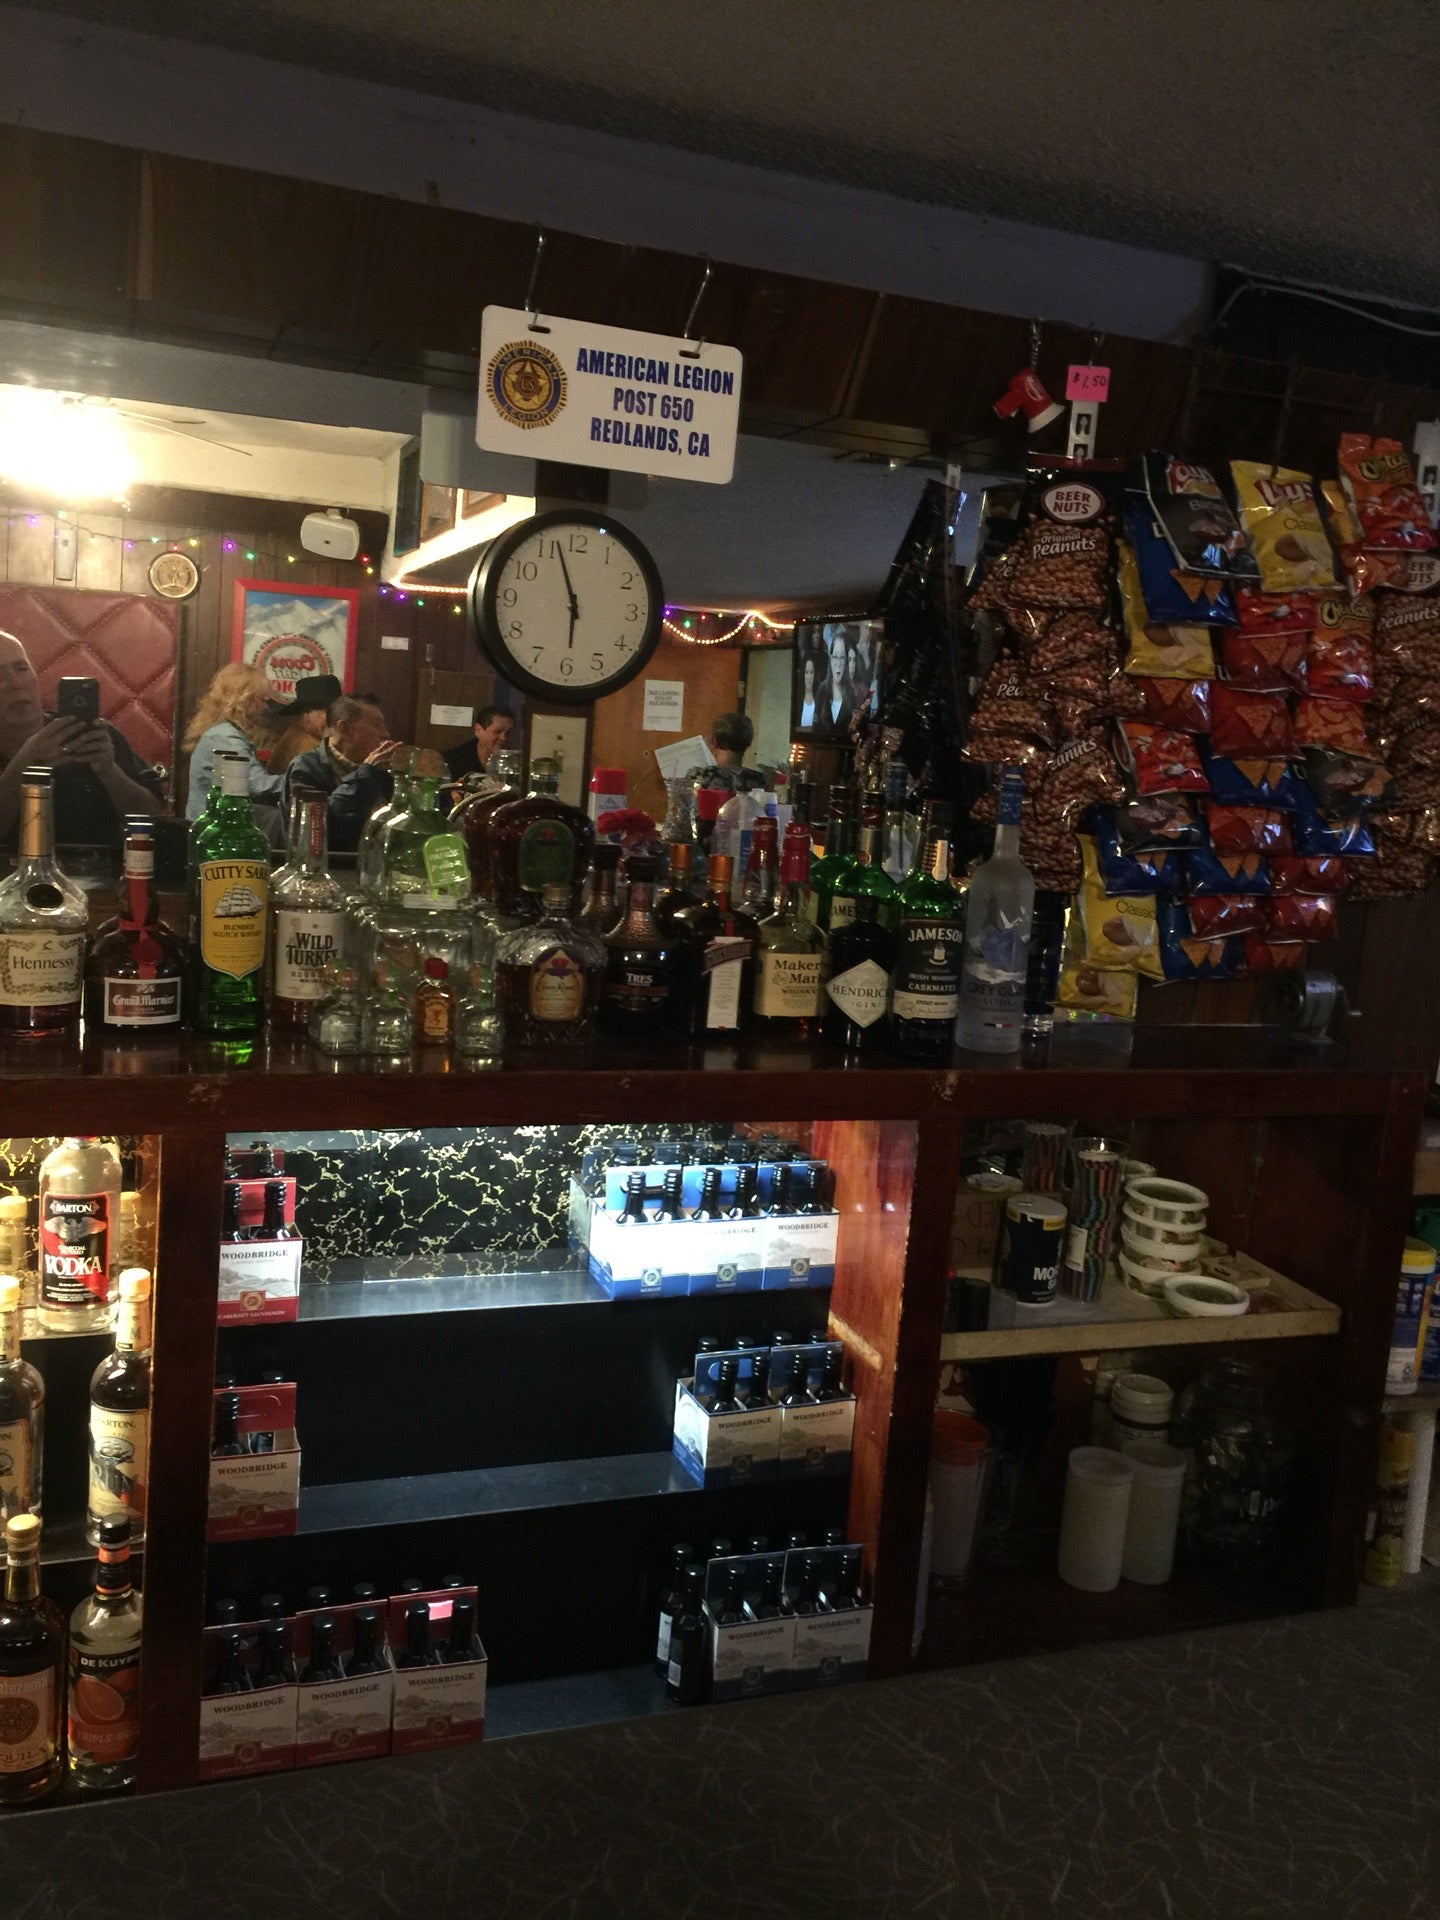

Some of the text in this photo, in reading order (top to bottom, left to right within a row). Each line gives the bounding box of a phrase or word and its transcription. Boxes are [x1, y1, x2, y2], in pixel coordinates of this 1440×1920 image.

[499, 348, 560, 381] AMERICAN
[576, 347, 734, 395] AMERICAN LEGION
[521, 379, 535, 391] US
[503, 401, 549, 421] LEGION
[612, 387, 694, 422] POST 650
[590, 416, 710, 457] REDLANDS, CA
[1055, 491, 1091, 503] BEER
[1053, 502, 1090, 515] NUTS
[569, 534, 588, 554] 12
[1041, 531, 1081, 544] Original
[538, 539, 556, 559] 11
[604, 547, 610, 565] 1
[1032, 537, 1097, 559] Peanuts
[516, 560, 538, 582] 10
[1410, 561, 1435, 572] EER
[620, 572, 633, 590] 2
[1410, 574, 1434, 585] UTS
[503, 588, 518, 608] 9
[625, 604, 639, 622] 3
[509, 620, 523, 639] 8
[614, 634, 627, 651] 4
[532, 646, 544, 664] 7
[590, 653, 604, 671] 5
[560, 657, 573, 676] 6
[205, 865, 243, 881] CUTTY
[295, 932, 333, 950] WILD
[13, 956, 74, 971] Hennessy
[285, 944, 339, 967] TURKEY
[625, 972, 654, 985] TRES
[55, 1203, 93, 1214] BARTON
[777, 1222, 829, 1232] WOODBRIDGE
[221, 1249, 289, 1260] WOODBRIDGE
[44, 1253, 103, 1276] VODKA
[718, 1416, 773, 1430] WOODBRIDGE
[793, 1408, 845, 1422] WOODBRIDGE
[217, 1461, 288, 1475] WOODBRIDGE
[80, 1656, 96, 1667] DE
[408, 1671, 475, 1687] WOODBRIDGE
[311, 1683, 381, 1701] WOODBRIDGE
[213, 1695, 285, 1714] WOODBRIDGE
